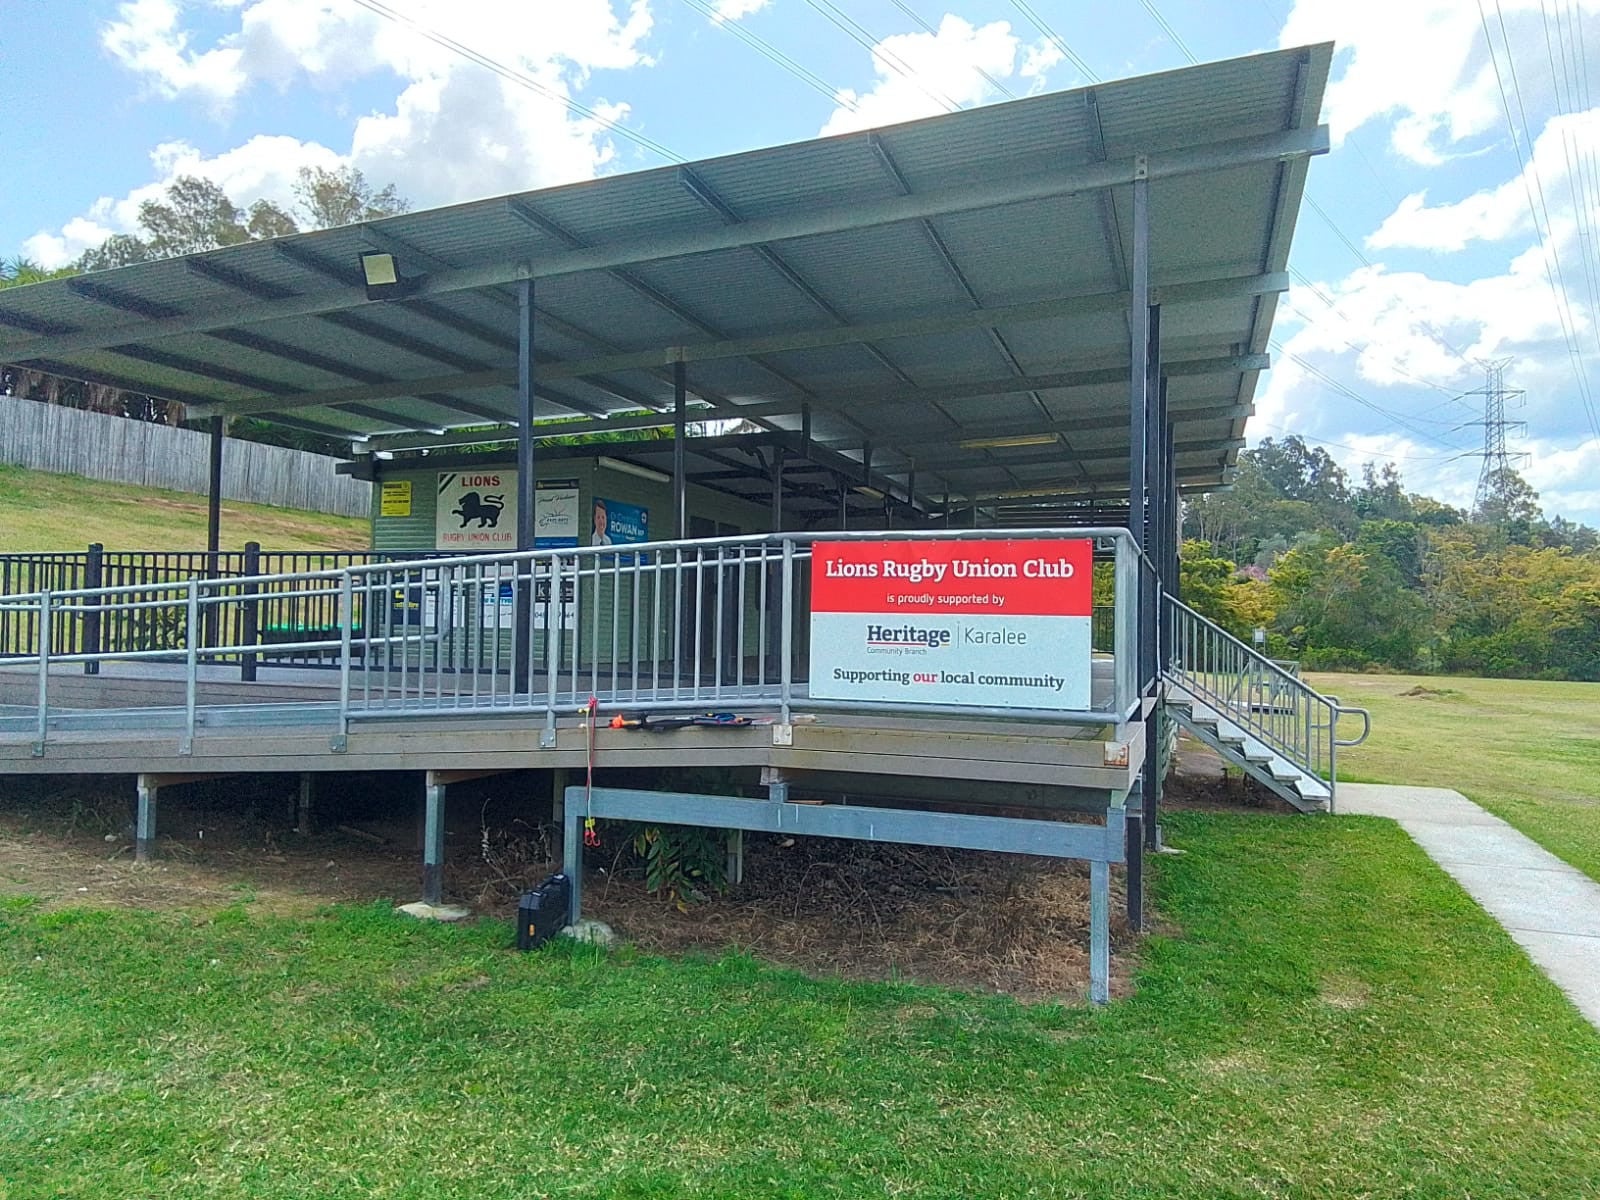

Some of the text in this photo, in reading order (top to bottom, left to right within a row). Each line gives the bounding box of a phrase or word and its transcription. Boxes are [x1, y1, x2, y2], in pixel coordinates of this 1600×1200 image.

[461, 475, 501, 487] LIONS
[610, 520, 638, 536] ROWAN
[443, 532, 512, 542] RUGBY UNION CLUB
[825, 558, 1074, 582] Lions Rugby Union Club
[887, 593, 1005, 606] is proudly supported by
[866, 625, 1027, 648] Heritage Karalee
[866, 647, 928, 656] Community Branch
[833, 668, 1065, 691] Supporting our local community
